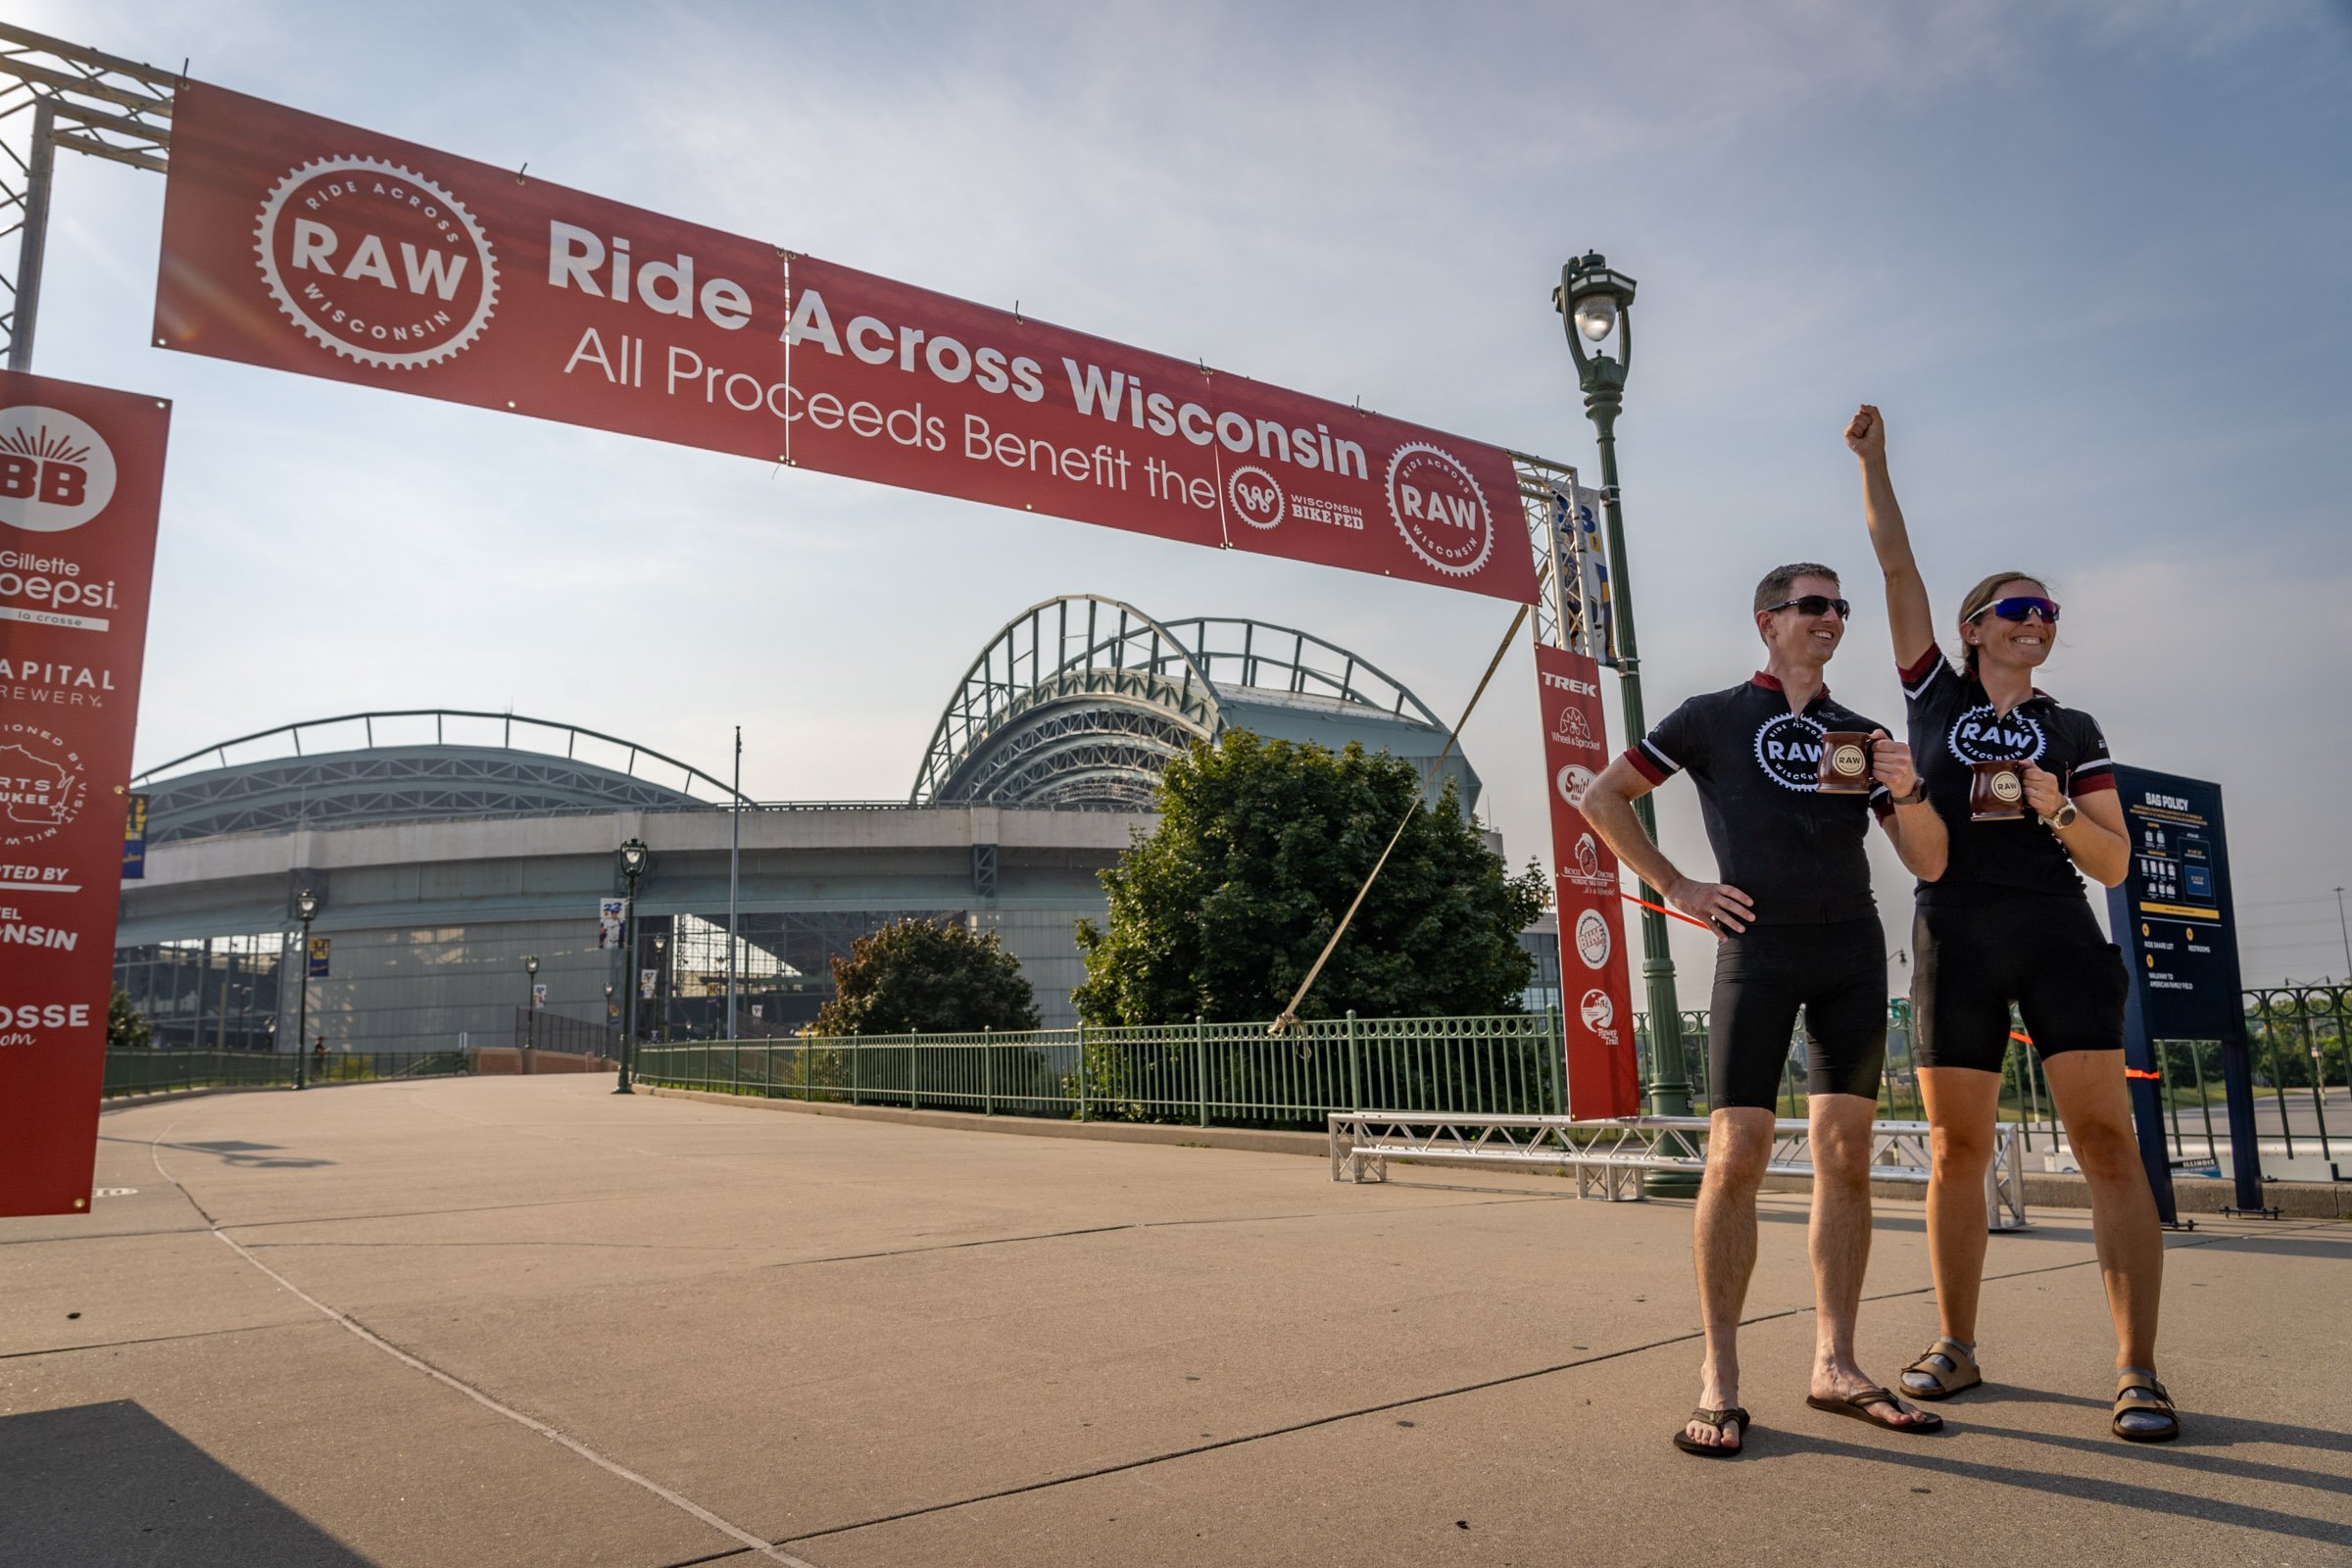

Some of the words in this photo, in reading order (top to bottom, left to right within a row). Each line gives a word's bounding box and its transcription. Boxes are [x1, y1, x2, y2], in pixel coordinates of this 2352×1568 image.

[306, 181, 357, 210] RIDE
[373, 183, 459, 243] ACROSS
[292, 218, 468, 302] RAW
[304, 282, 451, 340] WISCONSIN
[549, 220, 753, 329] Ride
[779, 288, 1044, 403] Across
[1062, 357, 1369, 480] Wisconsin
[564, 327, 642, 387] All
[668, 345, 946, 452] Proceeds
[965, 414, 1131, 491] Benefit
[1144, 457, 1215, 509] the
[1402, 458, 1423, 478] RIDE
[1427, 458, 1470, 493] ACROSS
[1290, 494, 1363, 516] WISCONSIN
[1292, 503, 1331, 524] BIKE
[1334, 513, 1364, 530] FED
[1400, 483, 1476, 530] RAW
[1413, 524, 1477, 559] WISCONSIN
[0, 550, 80, 576] Gillette
[36, 614, 82, 626] crosse
[1542, 671, 1597, 698] TREK
[1551, 730, 1571, 745] Wheel
[1575, 736, 1600, 751] Sprocket
[1961, 722, 2034, 750] RAW
[1767, 740, 1823, 762] RAW
[1962, 741, 2024, 760] WISCONSIN
[2145, 792, 2162, 807] BAG
[2162, 795, 2189, 811] POLICY
[0, 827, 58, 846] MILW
[0, 864, 39, 880] TED
[42, 866, 70, 881] BY
[0, 906, 22, 920] EL
[0, 923, 78, 952] NSIN
[1579, 926, 1606, 951] BIKE
[2187, 945, 2211, 954] RESTROOMS
[2182, 1158, 2215, 1168] ILLINOIS
